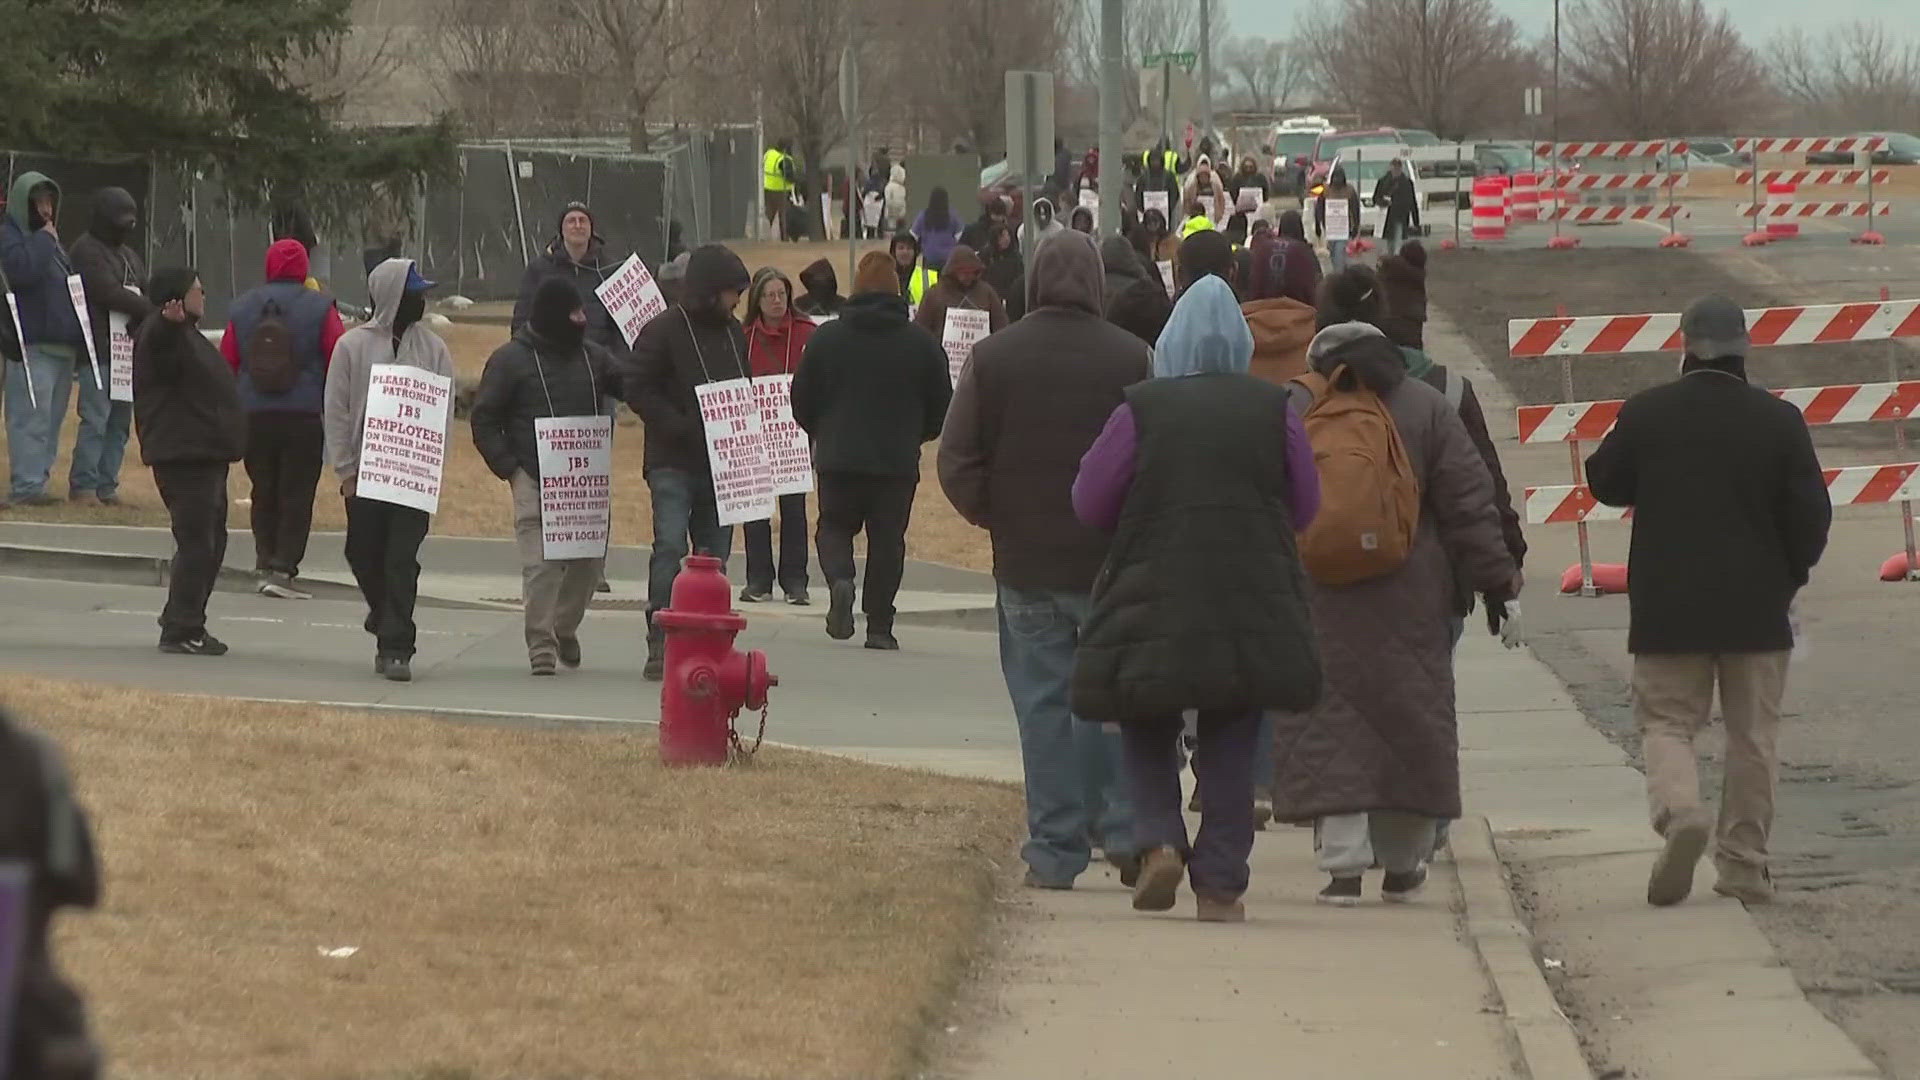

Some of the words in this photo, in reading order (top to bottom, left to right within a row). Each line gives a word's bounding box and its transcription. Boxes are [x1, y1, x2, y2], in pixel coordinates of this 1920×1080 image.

[601, 279, 624, 304] FAVOR
[623, 269, 634, 284] DE
[632, 261, 644, 274] NO
[628, 294, 642, 314] JBS
[624, 295, 660, 334] EMPLEADOS
[372, 375, 410, 387] PLEASE
[414, 379, 426, 390] DO
[429, 384, 447, 398] NOT
[770, 383, 783, 394] DE
[382, 386, 437, 406] PATRONIZE
[700, 388, 733, 408] FAVOR
[754, 395, 789, 408] TROCIN
[397, 404, 420, 419] JBS
[368, 417, 443, 444] EMPLOYEES
[539, 429, 576, 440] PLEASE
[577, 428, 591, 438] DO
[592, 427, 609, 438] NOT
[730, 419, 747, 435] JBS
[785, 430, 799, 439] POR
[366, 432, 380, 440] ON
[382, 434, 413, 447] UNFAIR
[416, 439, 442, 456] LABOR
[551, 440, 602, 451] PATRONIZE
[365, 442, 410, 458] PRACTICE
[412, 452, 441, 466] STRIKE
[779, 448, 807, 458] INJUSTAS
[568, 457, 589, 472] JBS
[361, 471, 391, 485] UFCW
[393, 477, 426, 493] LOCAL
[543, 475, 609, 488] EMPLOYEES
[773, 475, 798, 484] LOCAL
[544, 491, 557, 500] ON
[559, 490, 587, 499] UNFAIR
[544, 501, 586, 512] PRACTICE
[724, 501, 750, 512] UFCW
[545, 532, 573, 542] UFCW
[575, 531, 599, 540] LOCAL
